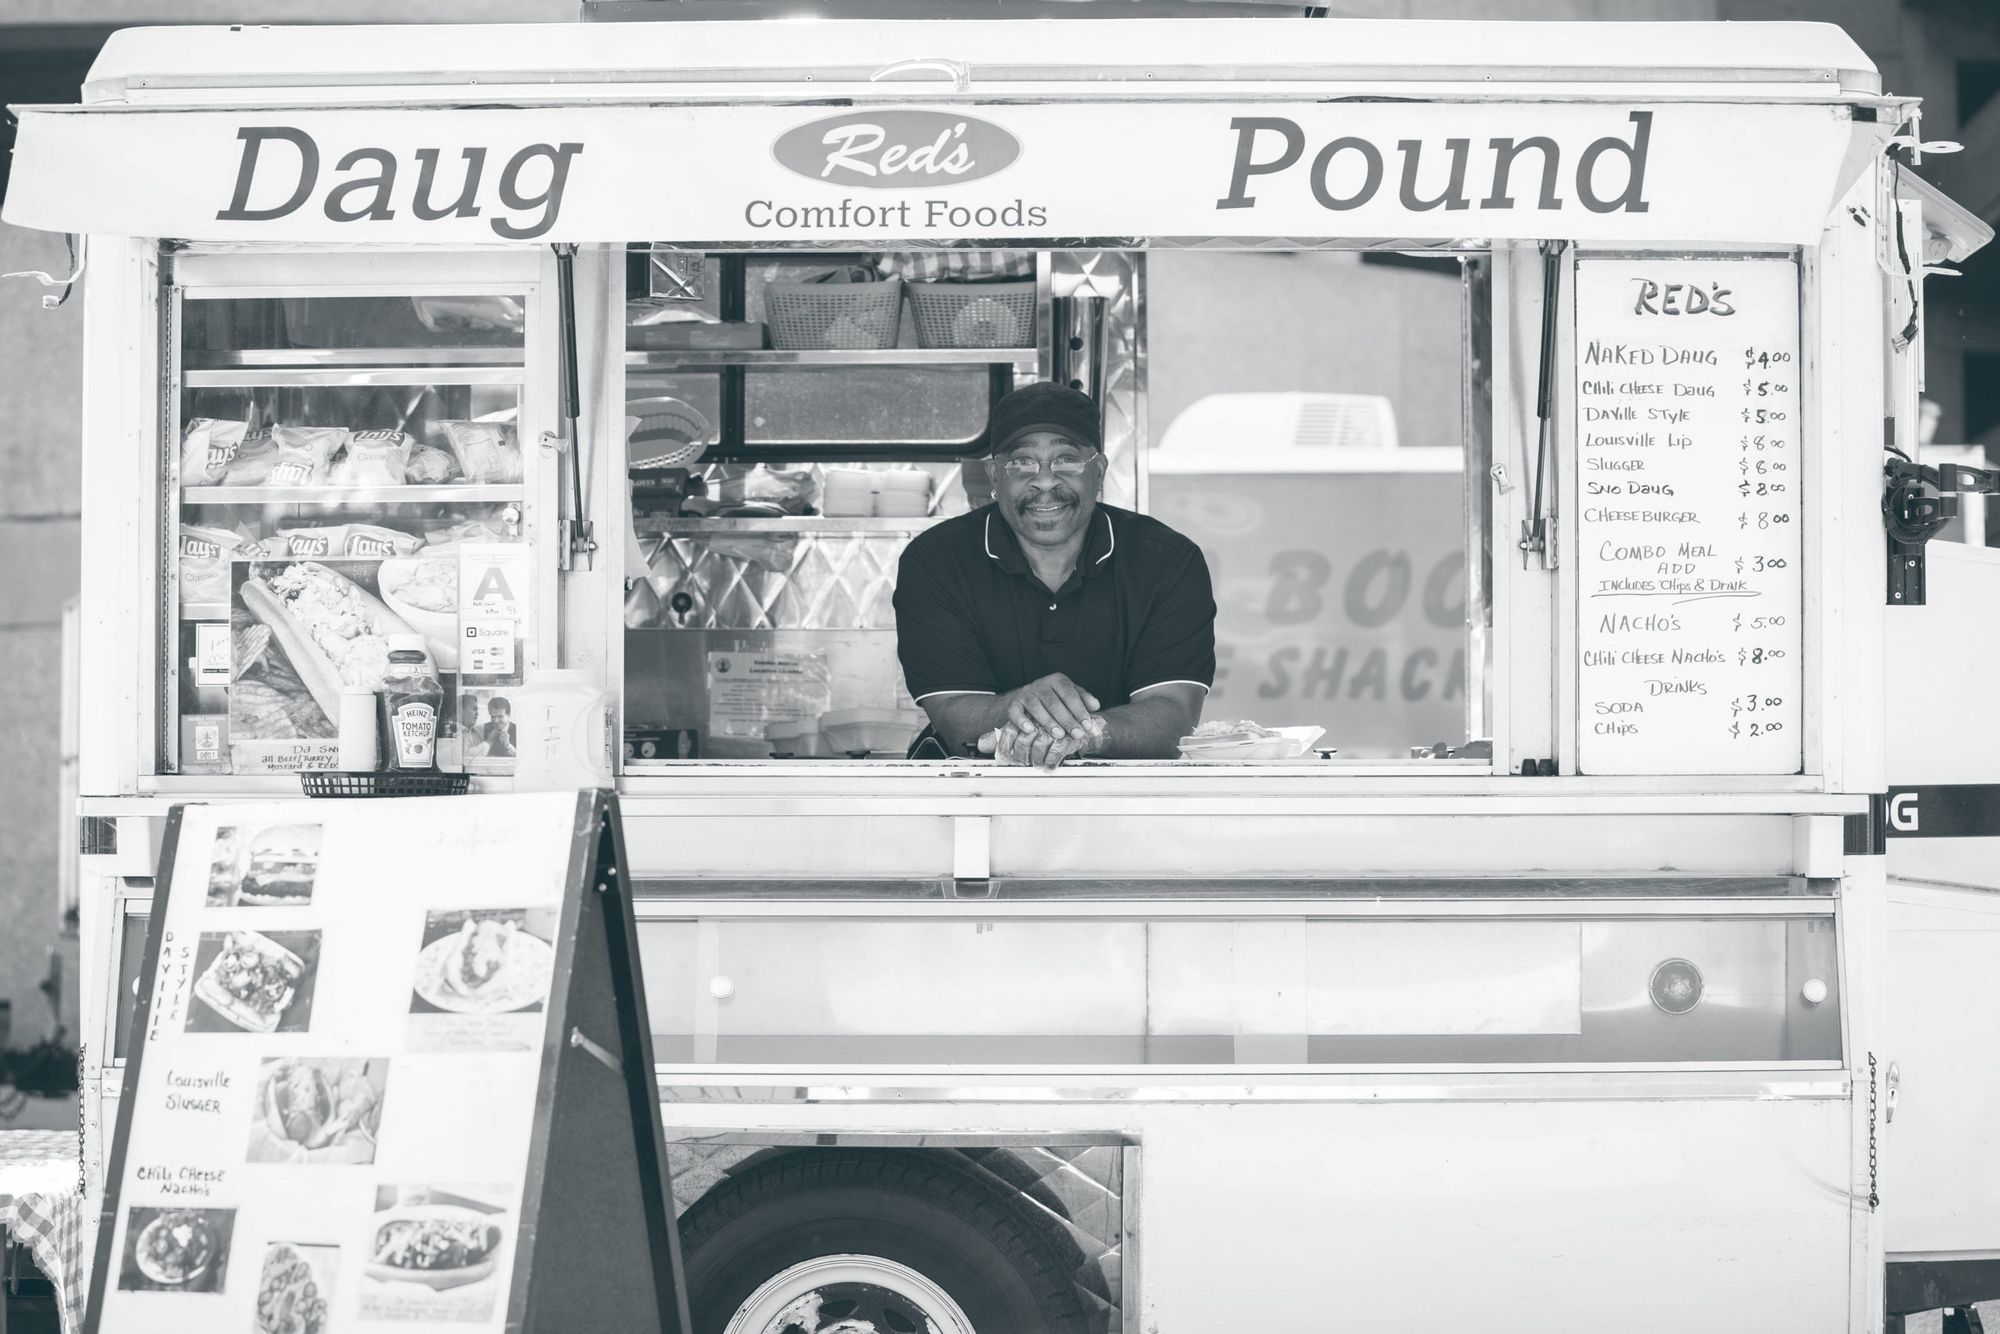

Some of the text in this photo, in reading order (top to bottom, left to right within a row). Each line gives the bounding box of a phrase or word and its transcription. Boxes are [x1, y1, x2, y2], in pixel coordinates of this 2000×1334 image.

[821, 122, 975, 178] Red's
[1216, 111, 1653, 214] Pound
[216, 125, 584, 239] Daug
[745, 198, 1047, 228] Comfort Foods
[1631, 278, 1736, 316] RED'S
[1585, 342, 1654, 366] NAKED
[1659, 346, 1718, 366] DAUG
[1619, 380, 1664, 395] CHEESE
[1599, 540, 1718, 561] COMBO MEAL
[1657, 562, 1696, 575] ADD
[473, 567, 515, 601] A
[1694, 579, 1705, 591] &
[479, 628, 509, 638] Square
[1621, 649, 1664, 664] CHEESE
[406, 710, 428, 718] HEINZ
[1595, 702, 1643, 714] SODA
[401, 722, 431, 730] TOMATO
[319, 745, 338, 754] SN
[1886, 793, 1918, 831] G
